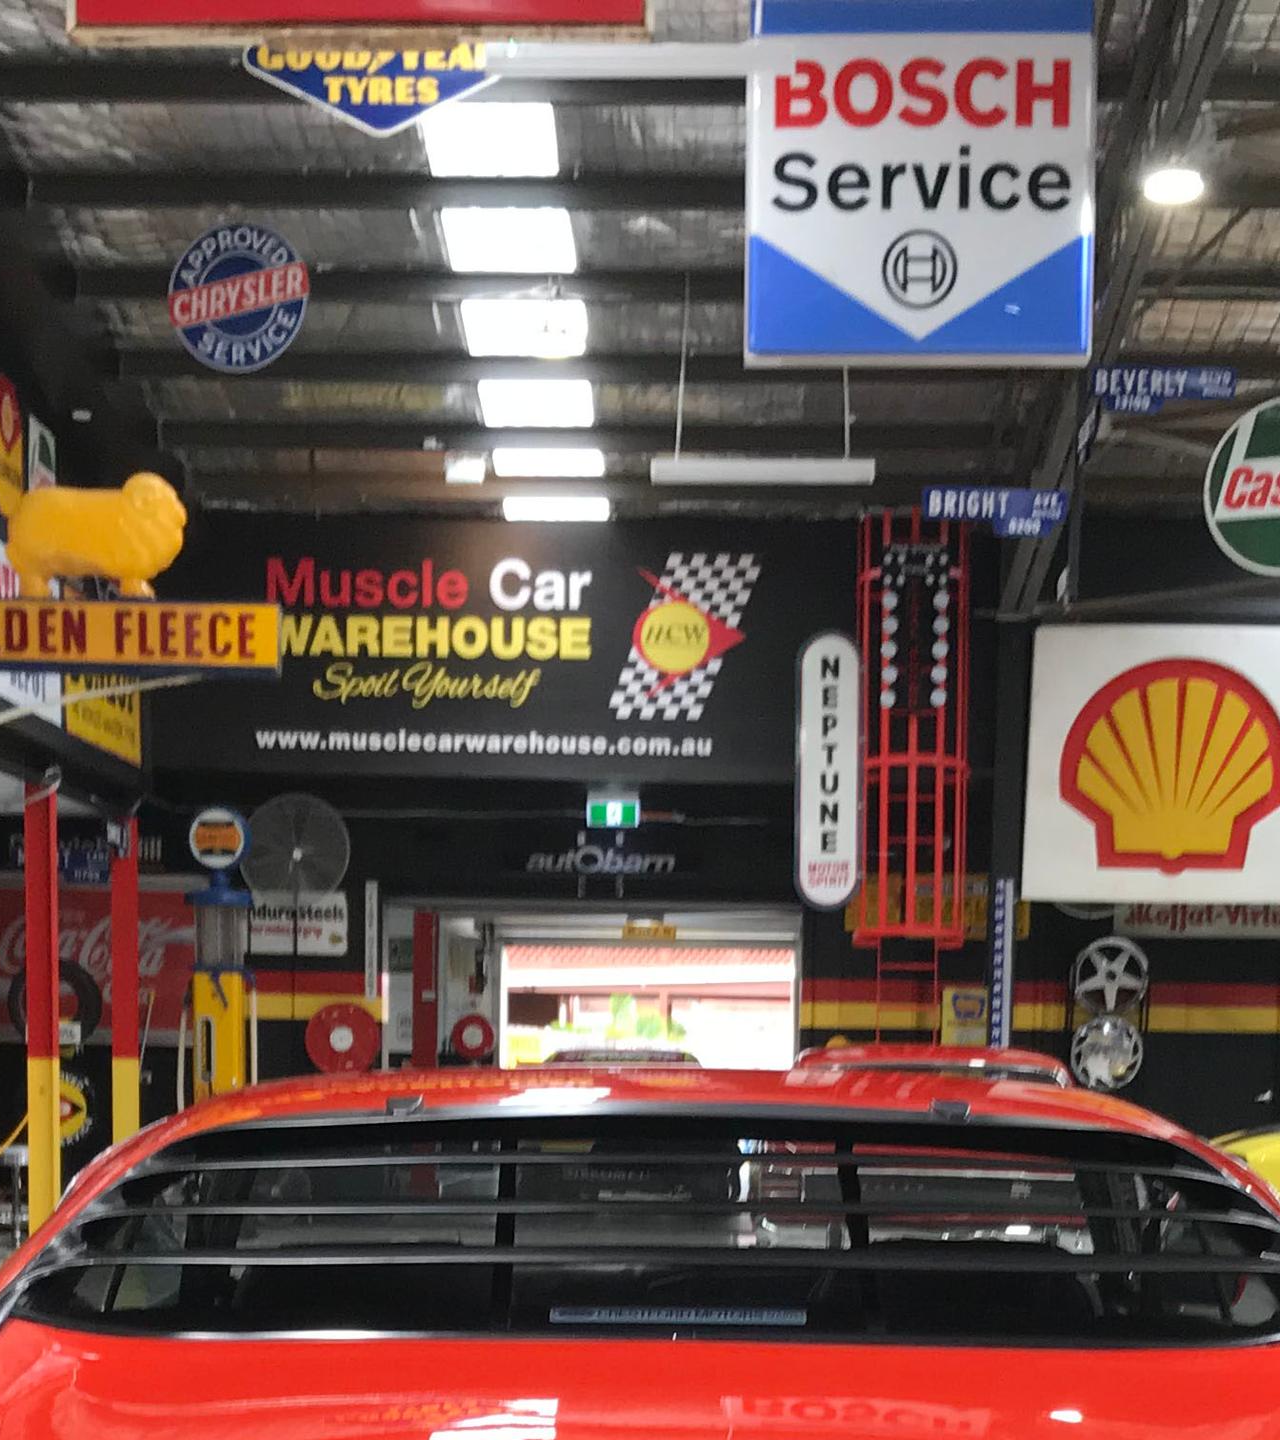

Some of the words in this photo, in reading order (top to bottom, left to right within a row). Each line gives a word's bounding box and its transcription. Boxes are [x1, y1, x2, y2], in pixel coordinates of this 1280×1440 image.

[323, 76, 440, 106] TYRES
[773, 57, 1072, 129] BOSCH
[771, 146, 1072, 212] Service
[180, 227, 288, 287] APPROVED
[173, 266, 304, 323] CHRYSLER
[198, 308, 297, 366] SERVICE
[1095, 368, 1188, 398] BEVERLY
[928, 489, 1010, 519] BRIGHT
[266, 556, 469, 610] Muscle
[490, 557, 592, 611] Car
[114, 609, 256, 659] FLEECE
[280, 615, 592, 661] WAREHOUSE
[312, 662, 399, 706] Spoil
[402, 661, 541, 709] Yourself
[255, 728, 713, 758] www.musclecarwarehouse.com.au
[820, 655, 840, 854] NEPTUNE
